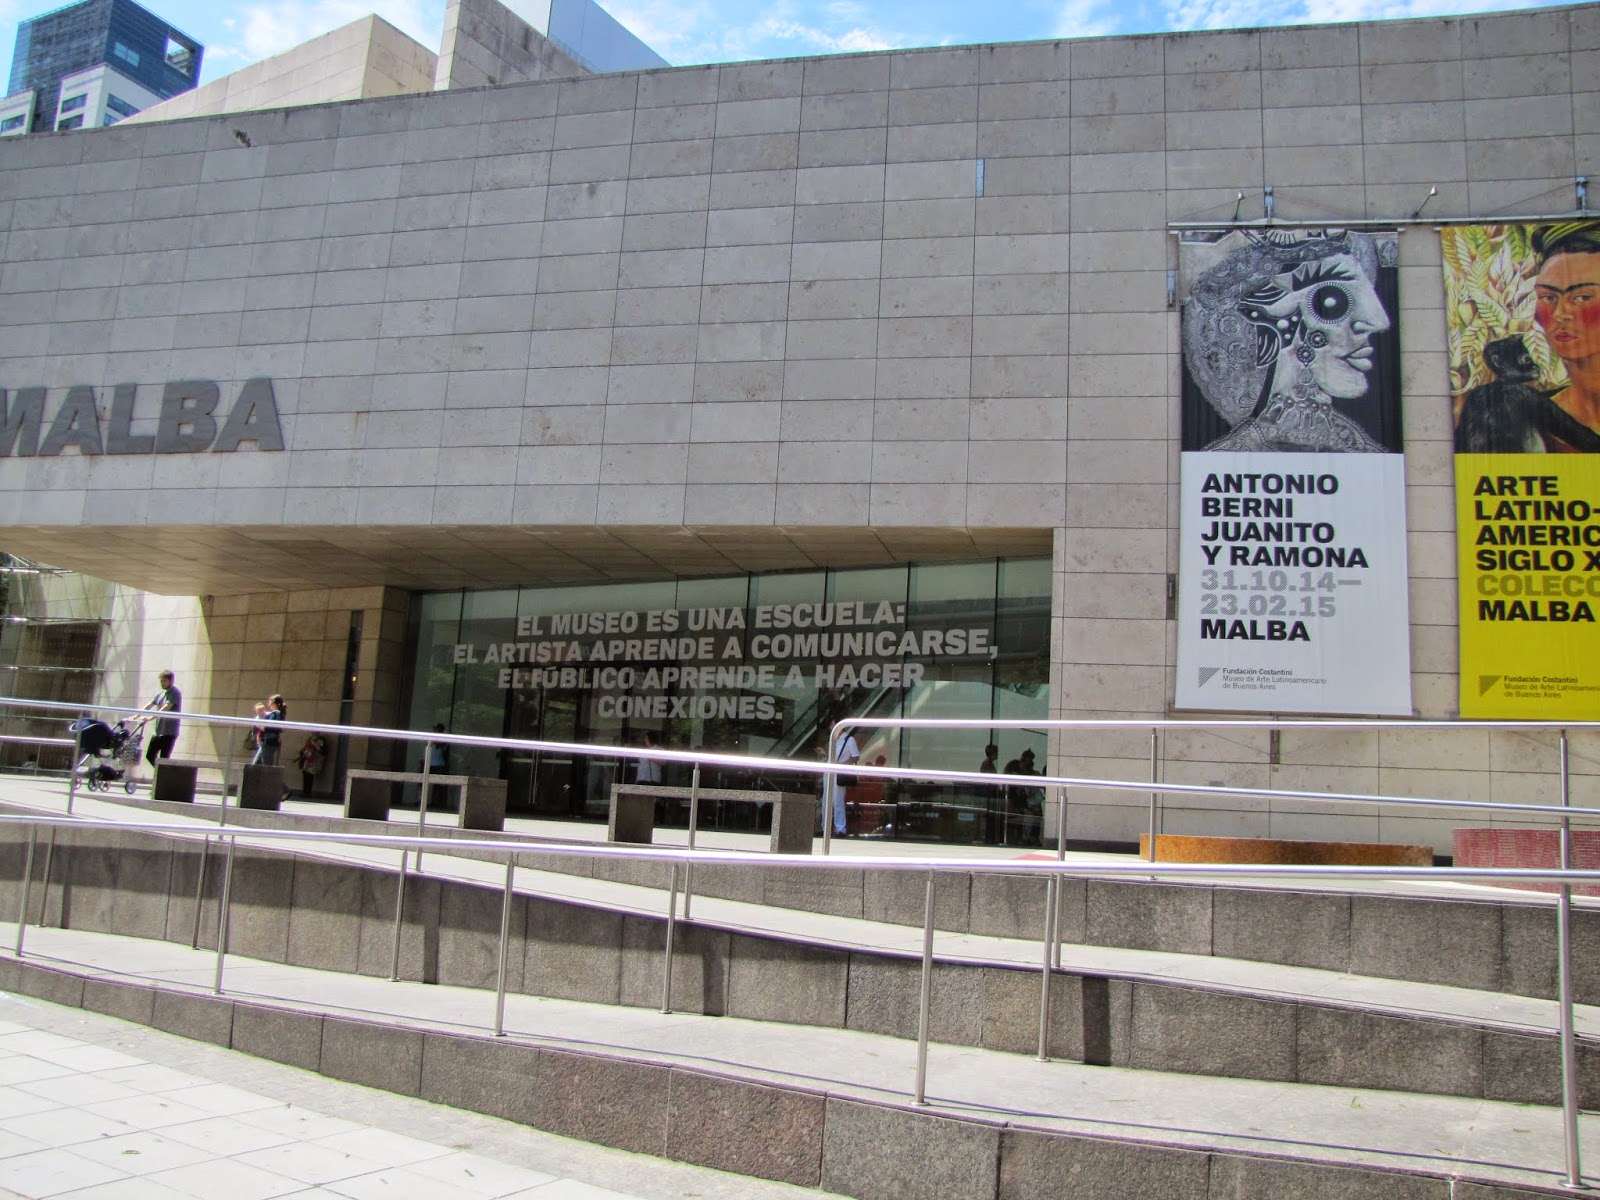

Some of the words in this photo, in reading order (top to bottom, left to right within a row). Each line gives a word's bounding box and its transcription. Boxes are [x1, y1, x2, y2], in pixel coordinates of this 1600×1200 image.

[0, 377, 285, 457] MALBA
[1201, 473, 1339, 495] ANTONIO
[1474, 476, 1559, 496] ARTE
[1201, 497, 1293, 518] BERNI
[1201, 521, 1335, 543] JUANITO
[1201, 545, 1222, 566] Y
[1230, 546, 1369, 568] RAMONA
[1476, 549, 1575, 572] SIGLO
[1201, 593, 1336, 617] 23.02.15
[1478, 600, 1596, 623] MALBA
[517, 616, 543, 636] EL
[551, 611, 638, 635] MUSEO
[646, 609, 679, 632] ES
[688, 607, 745, 631] UNA
[755, 600, 905, 629] ESCUELA:
[1201, 618, 1310, 641] MALBA
[454, 645, 477, 663] EL
[484, 641, 583, 663] ARTISTA
[589, 637, 714, 661] APRENDE
[721, 636, 742, 659] A
[751, 628, 999, 660] COMUNICARSE,
[498, 669, 524, 689] EL
[531, 666, 635, 689] PÚBLICO
[642, 665, 775, 689] APRENDE
[783, 665, 805, 689] A
[815, 663, 924, 688] HACER
[1222, 667, 1257, 675] Fundación
[1258, 668, 1293, 676] Costantini
[1272, 676, 1327, 684] Latinoamericano
[1504, 675, 1540, 683] Fundación
[1542, 675, 1578, 684] Costantini
[1543, 691, 1562, 699] Aires
[598, 696, 783, 720] CONEXIONES.
